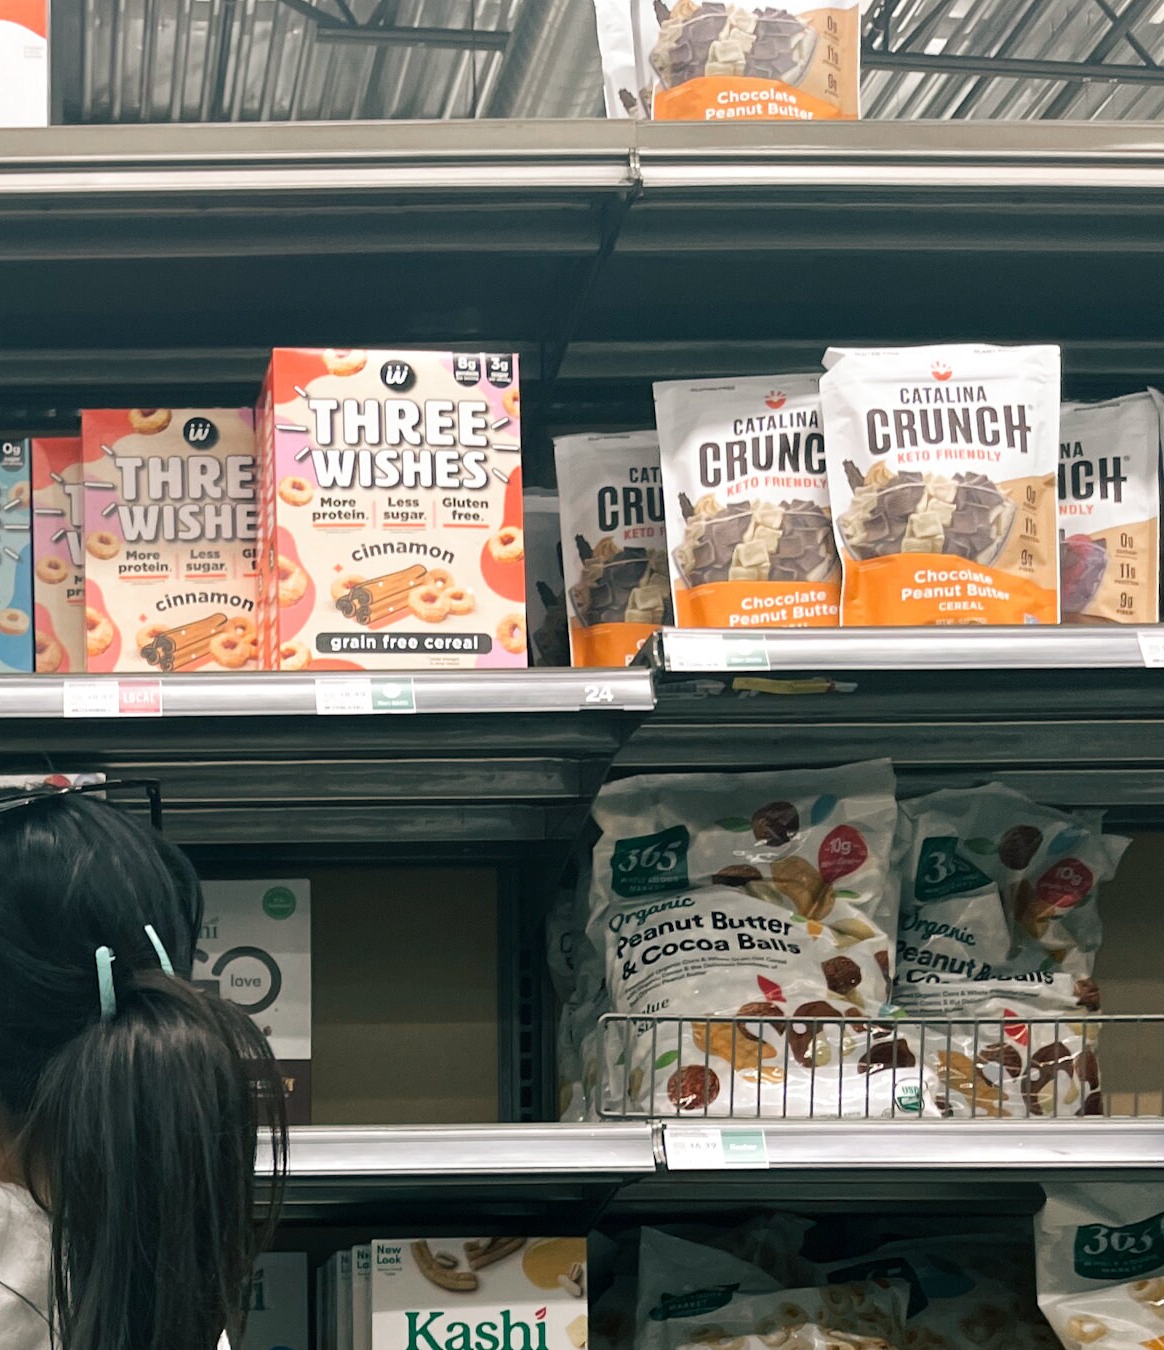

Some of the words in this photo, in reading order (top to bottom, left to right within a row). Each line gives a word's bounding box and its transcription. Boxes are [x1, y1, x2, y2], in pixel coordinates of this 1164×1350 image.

[717, 88, 797, 105] Chocolate
[900, 386, 987, 405] CATALINA
[308, 399, 488, 447] THREE
[733, 410, 818, 436] CATALINA
[866, 405, 1031, 455] CRUNCH
[310, 450, 488, 489] WISHES
[320, 497, 356, 508] More
[388, 497, 419, 508] Less
[442, 498, 488, 509] Gluten
[312, 509, 369, 521] protein.
[384, 510, 427, 521] sugar.
[451, 511, 484, 522] free.
[351, 542, 455, 564] cinnamon
[914, 569, 993, 584] Chocolate
[741, 589, 826, 611] Chocolate
[901, 584, 961, 601] Peanut
[967, 583, 1010, 600] Butter
[938, 601, 984, 611] CEREAL
[729, 606, 787, 626] Peanut
[331, 637, 376, 651] grain
[383, 635, 418, 649] free
[424, 636, 478, 649] cereal
[585, 686, 614, 702] 24
[619, 839, 681, 873] 365
[616, 913, 703, 960] Peanut
[711, 912, 793, 936] Butter
[641, 938, 730, 967] Cocoa
[739, 933, 801, 955] Balls
[230, 974, 261, 987] love
[377, 1245, 402, 1255] New
[377, 1255, 402, 1265] Look
